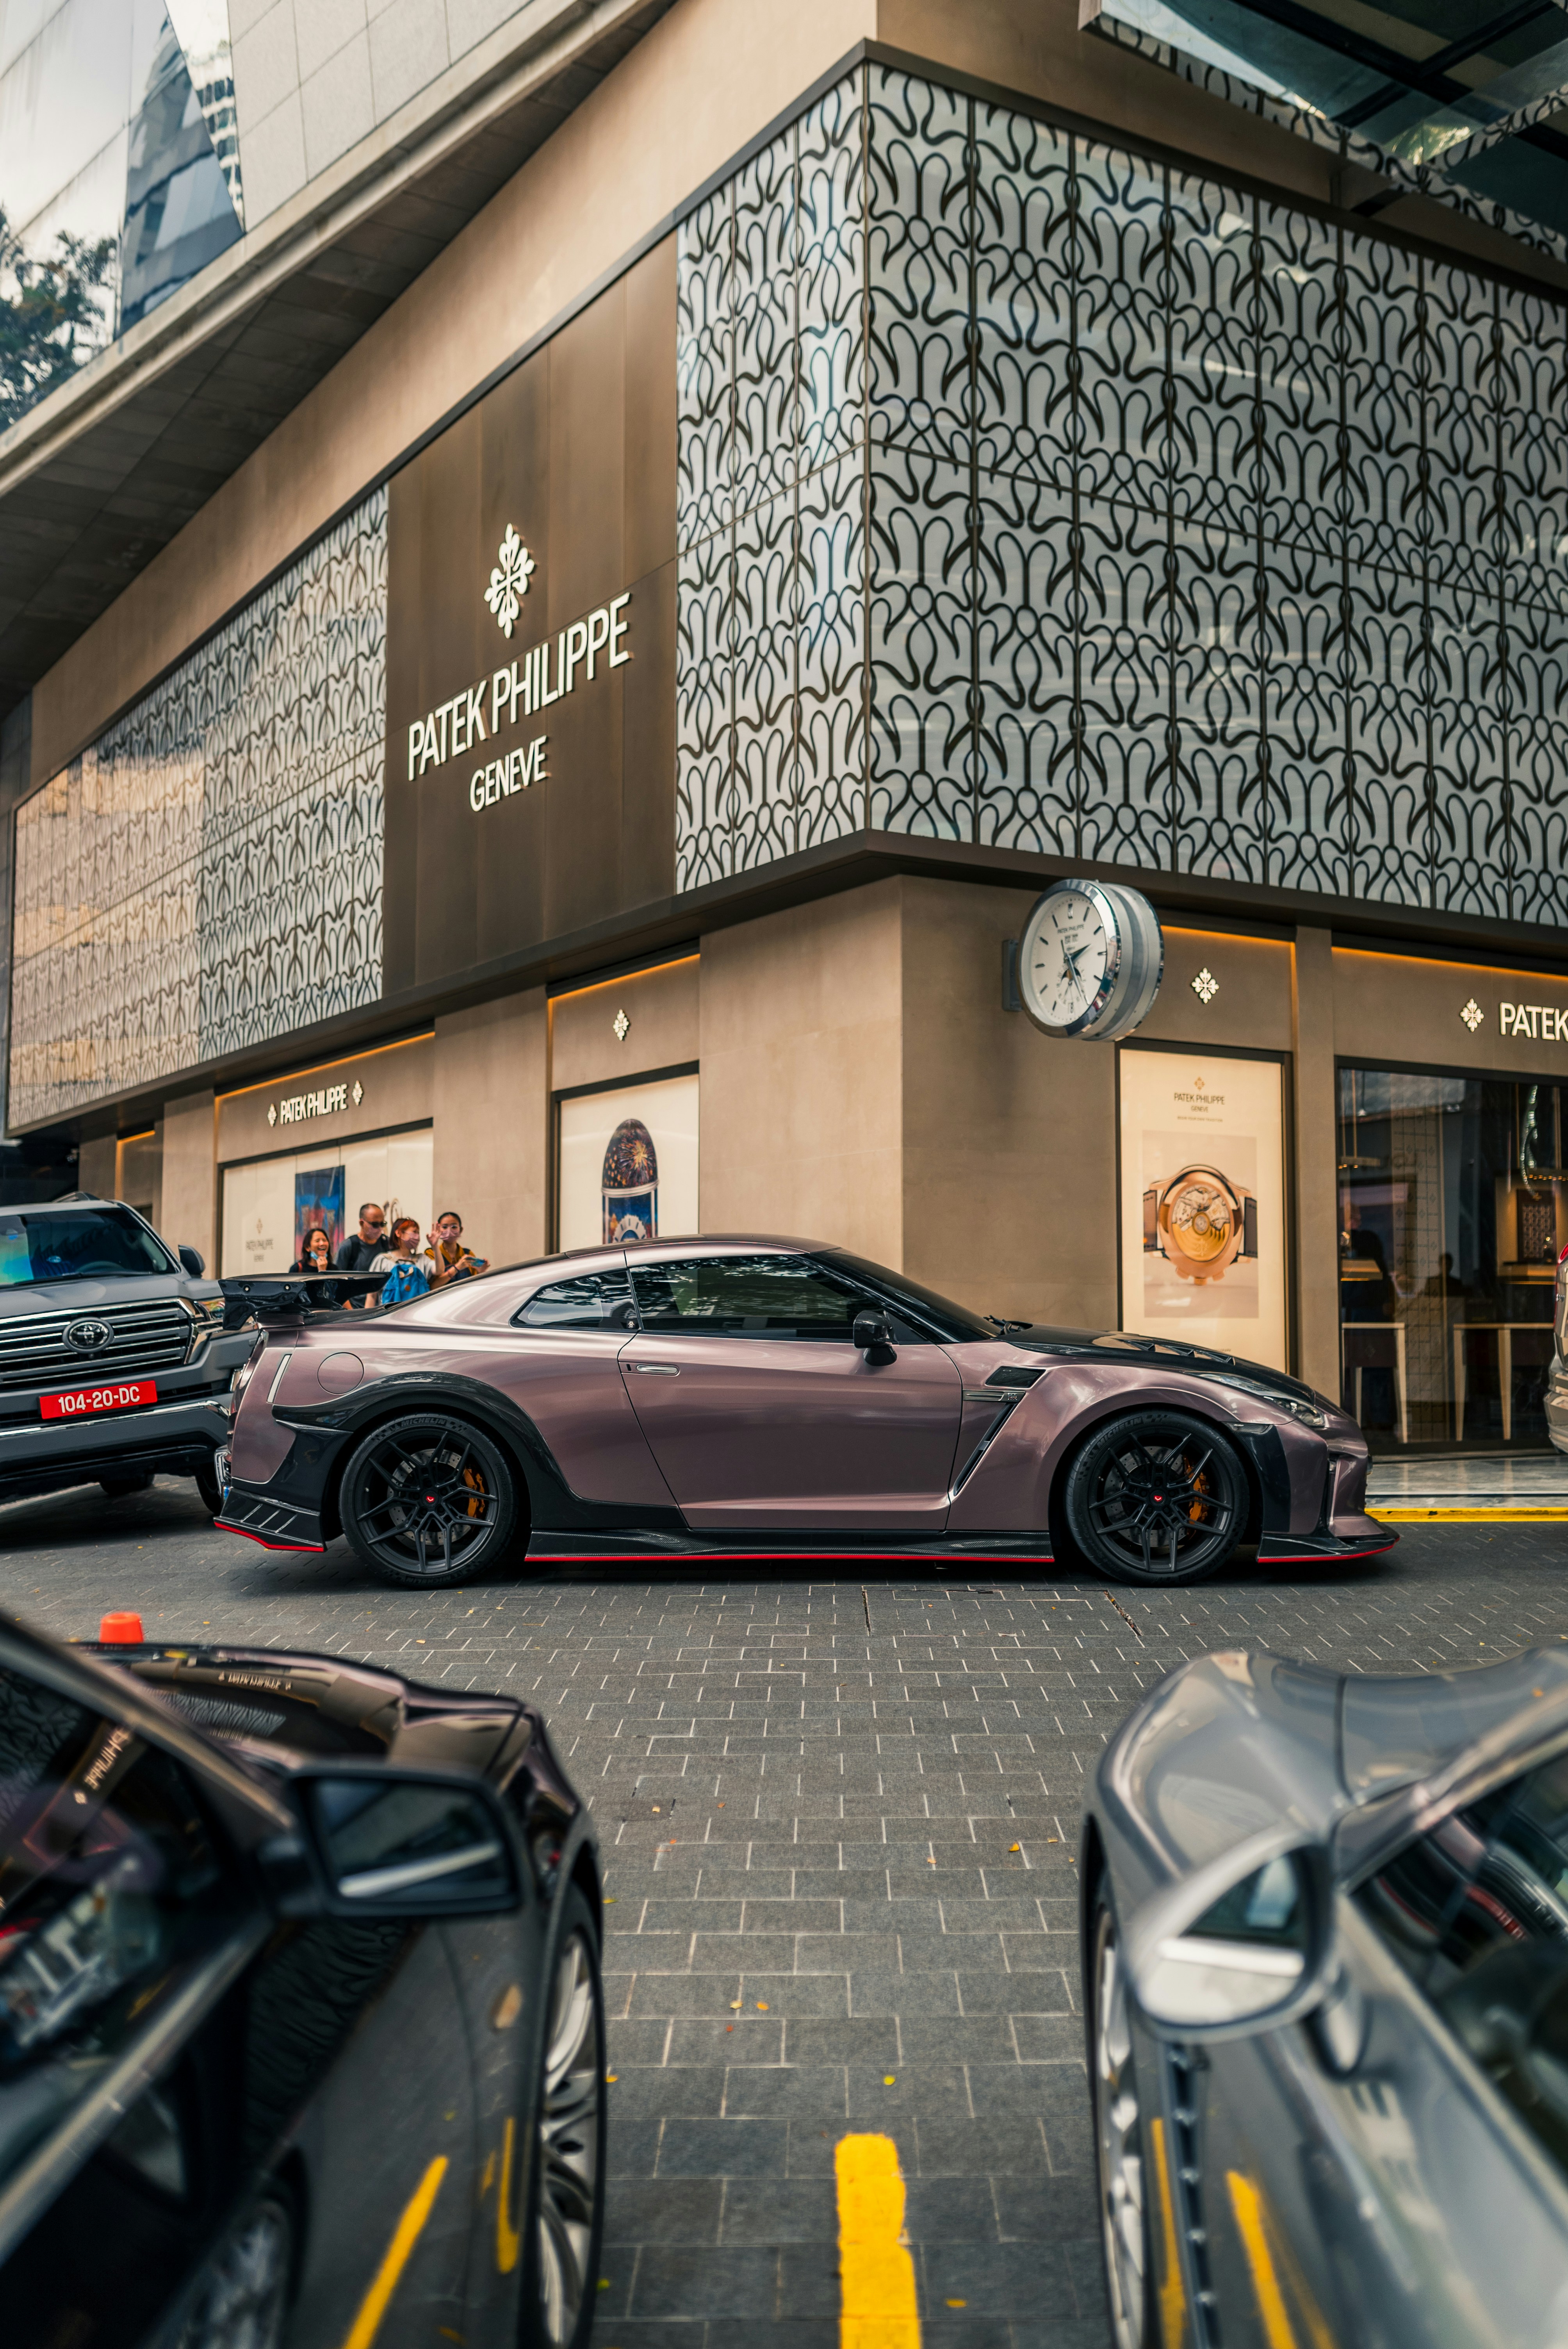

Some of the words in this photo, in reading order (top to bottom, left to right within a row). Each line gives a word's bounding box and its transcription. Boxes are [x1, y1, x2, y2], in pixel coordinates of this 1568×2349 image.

[408, 679, 488, 781] PATEK
[492, 592, 632, 734] PHILIPPE
[470, 735, 549, 812] GENEVE
[1500, 1002, 1568, 1042] PATEK
[280, 1094, 307, 1125] PATEK
[307, 1083, 347, 1118] PHILIPPE
[1174, 1093, 1195, 1103] PATEK
[1196, 1094, 1225, 1105] PHILIPPE
[58, 1386, 140, 1413] 104-20-DC
[401, 1417, 446, 1426] MICHELIN
[1097, 1417, 1142, 1449] MICHELIN
